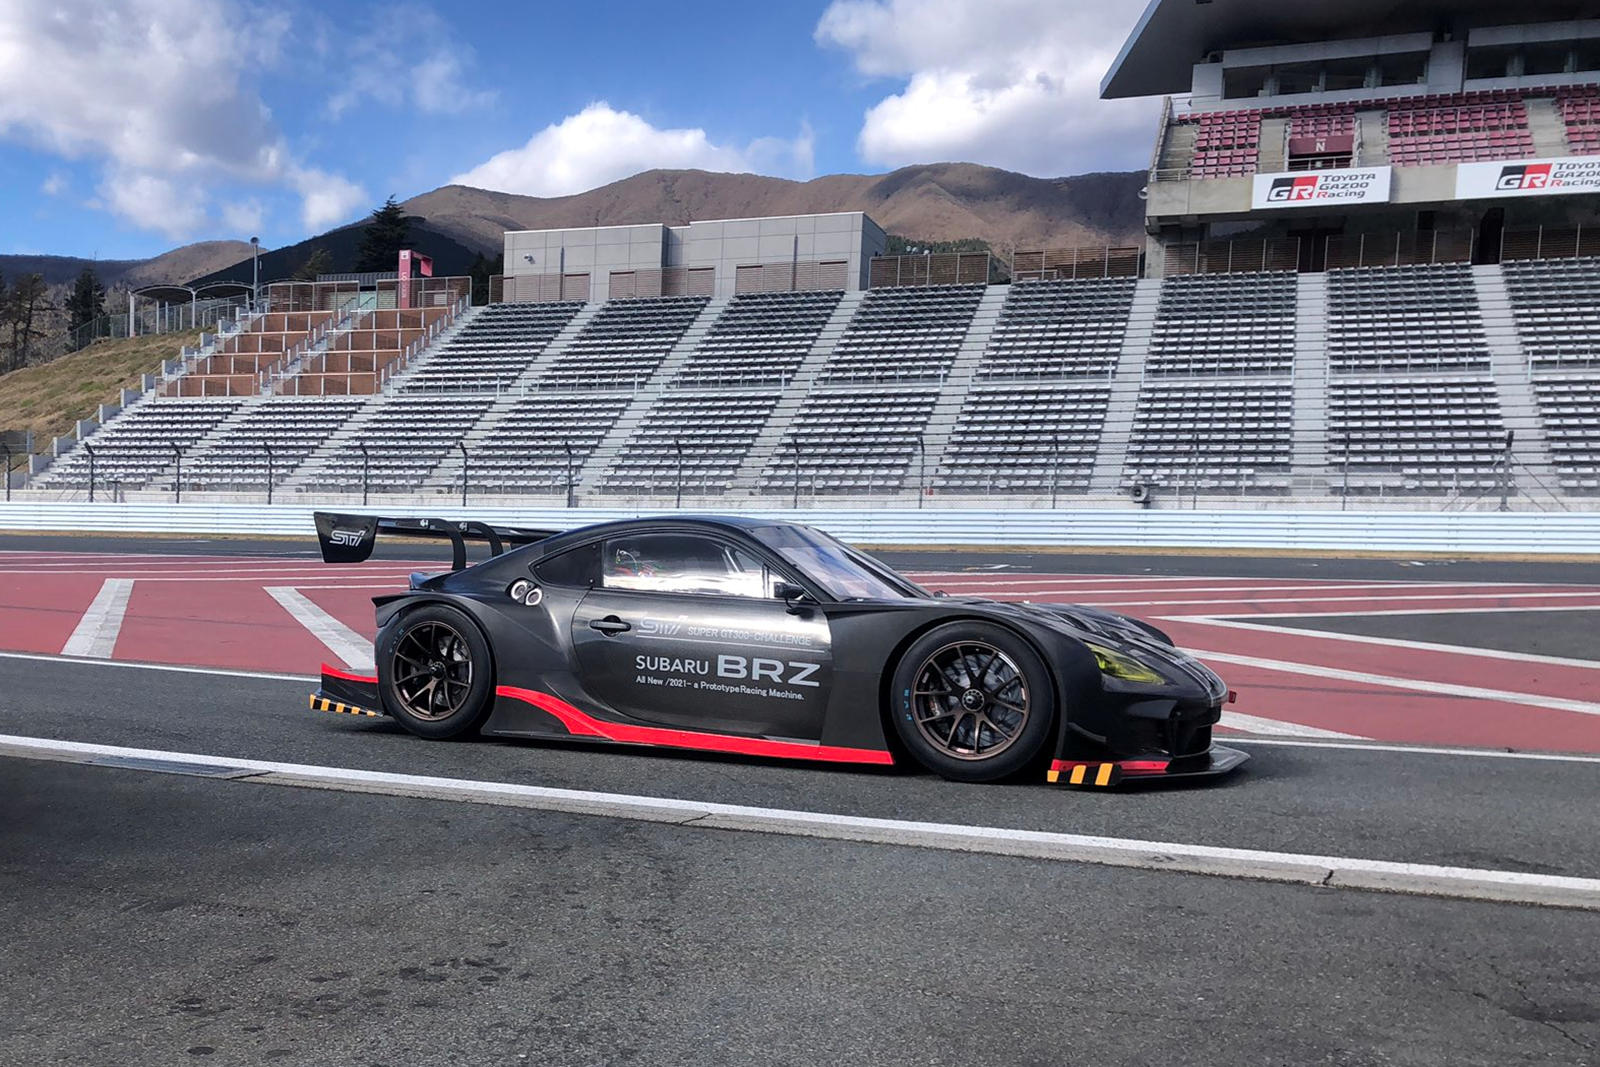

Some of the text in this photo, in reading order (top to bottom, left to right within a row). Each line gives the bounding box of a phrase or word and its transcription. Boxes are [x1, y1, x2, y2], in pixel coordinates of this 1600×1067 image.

[1322, 173, 1376, 183] TOYOTA
[1497, 173, 1549, 190] GR
[1268, 185, 1316, 201] GR
[1319, 181, 1369, 191] GAZOO
[1316, 189, 1366, 199] Racing
[687, 626, 719, 638] SUPER
[635, 654, 821, 687] SUBARU BRZ
[635, 675, 646, 684] All
[647, 676, 664, 686] New
[768, 688, 805, 700] Machine.
